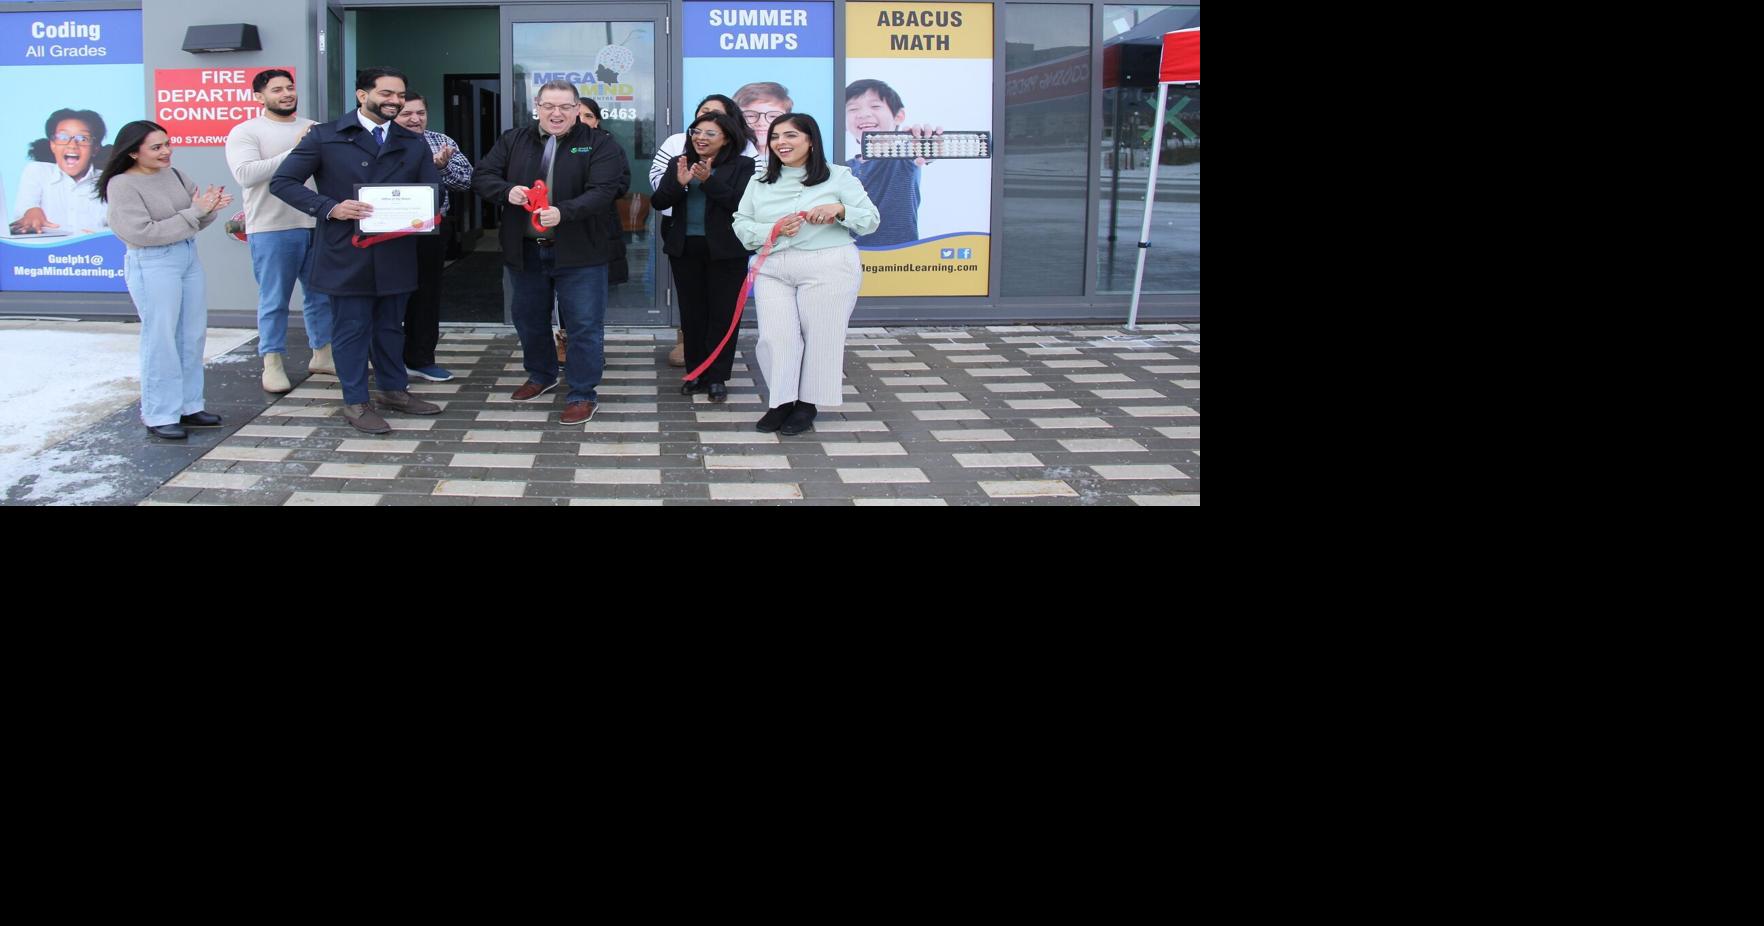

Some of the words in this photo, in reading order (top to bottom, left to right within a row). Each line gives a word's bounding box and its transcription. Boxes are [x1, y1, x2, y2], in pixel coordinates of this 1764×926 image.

[709, 9, 808, 27] SUMMER
[876, 10, 963, 28] ABACUS
[31, 21, 101, 41] Coding
[719, 32, 799, 51] CAMPS
[890, 34, 950, 51] MATH
[25, 45, 45, 58] All
[49, 44, 107, 57] Grades
[201, 70, 246, 84] FIRE
[533, 72, 596, 84] MEGA
[158, 88, 256, 103] DEPARTM
[580, 83, 634, 96] MIND
[159, 106, 265, 121] CONNECTI
[170, 135, 183, 144] 90
[185, 135, 228, 144] STARWO
[48, 254, 103, 266] Guelph1@
[13, 266, 124, 279] MegaMindLearning.c
